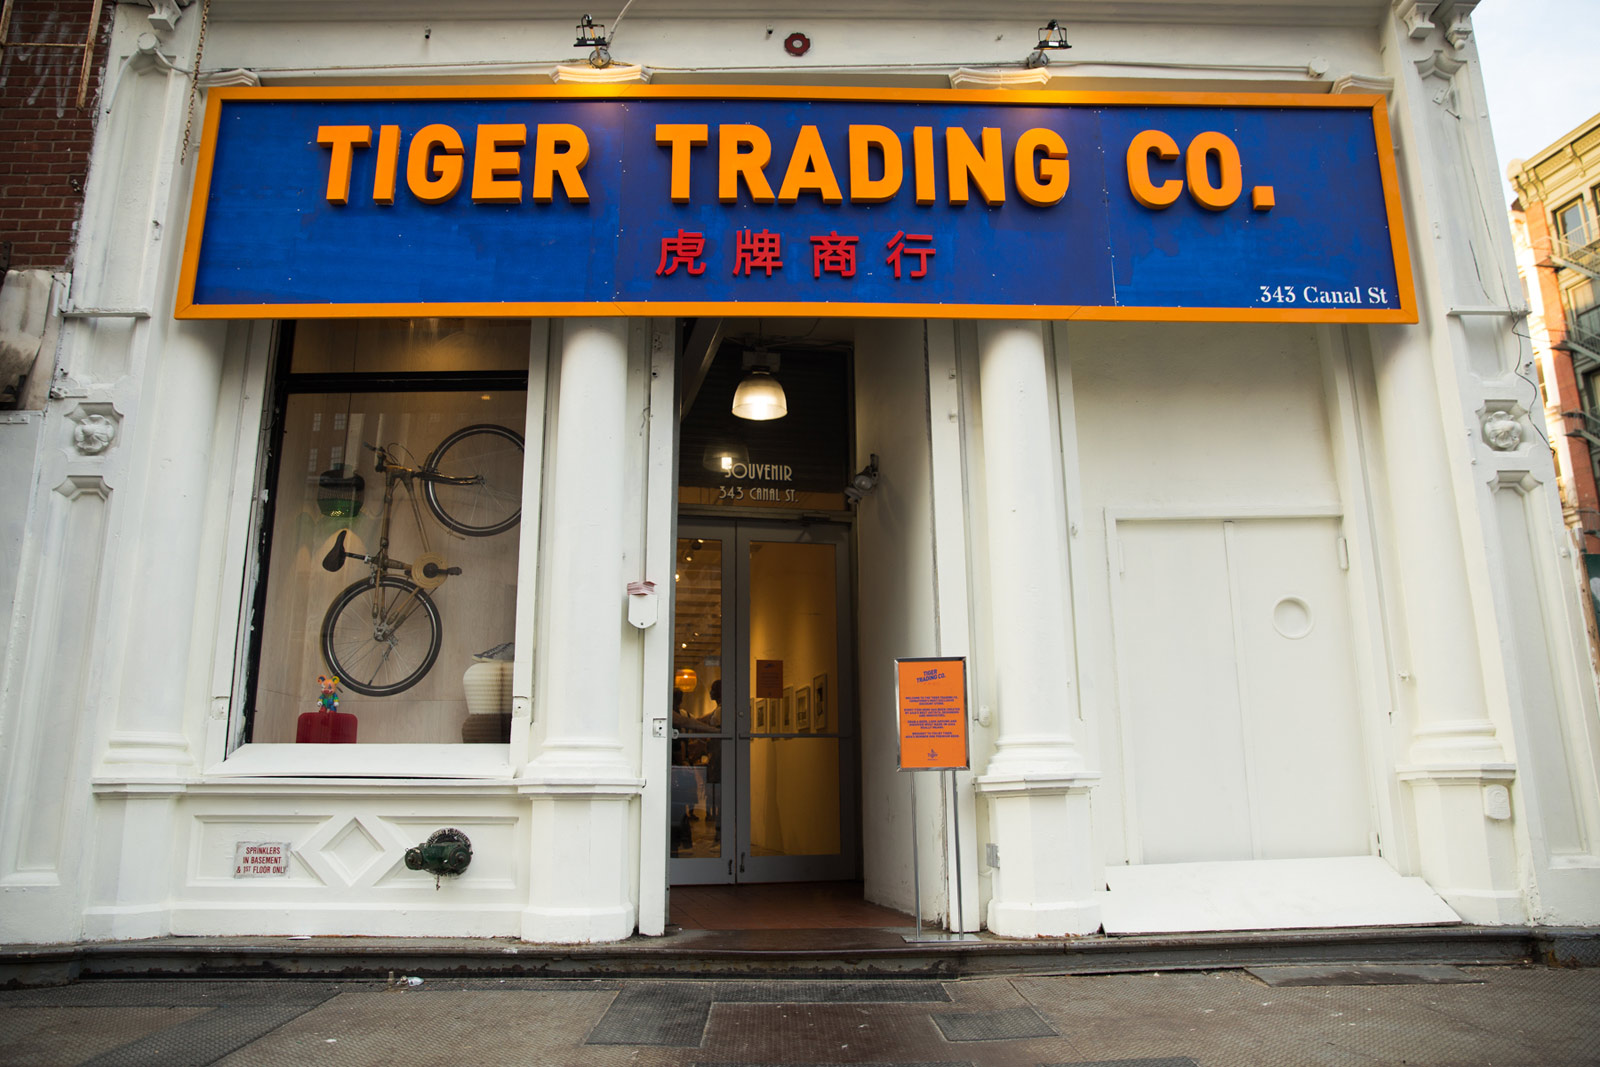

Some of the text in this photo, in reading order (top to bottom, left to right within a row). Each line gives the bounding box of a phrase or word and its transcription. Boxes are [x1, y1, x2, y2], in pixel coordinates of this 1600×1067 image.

[317, 123, 1275, 211] TIGER TRADING CO.
[656, 229, 936, 279] 虎牌商行
[1260, 286, 1388, 304] 343 Canal St
[719, 485, 744, 500] 343
[749, 487, 780, 502] CANAL
[245, 846, 281, 855] SPRINKLERS
[242, 856, 282, 865] IN BASEMENT
[252, 865, 271, 874] FLOOR
